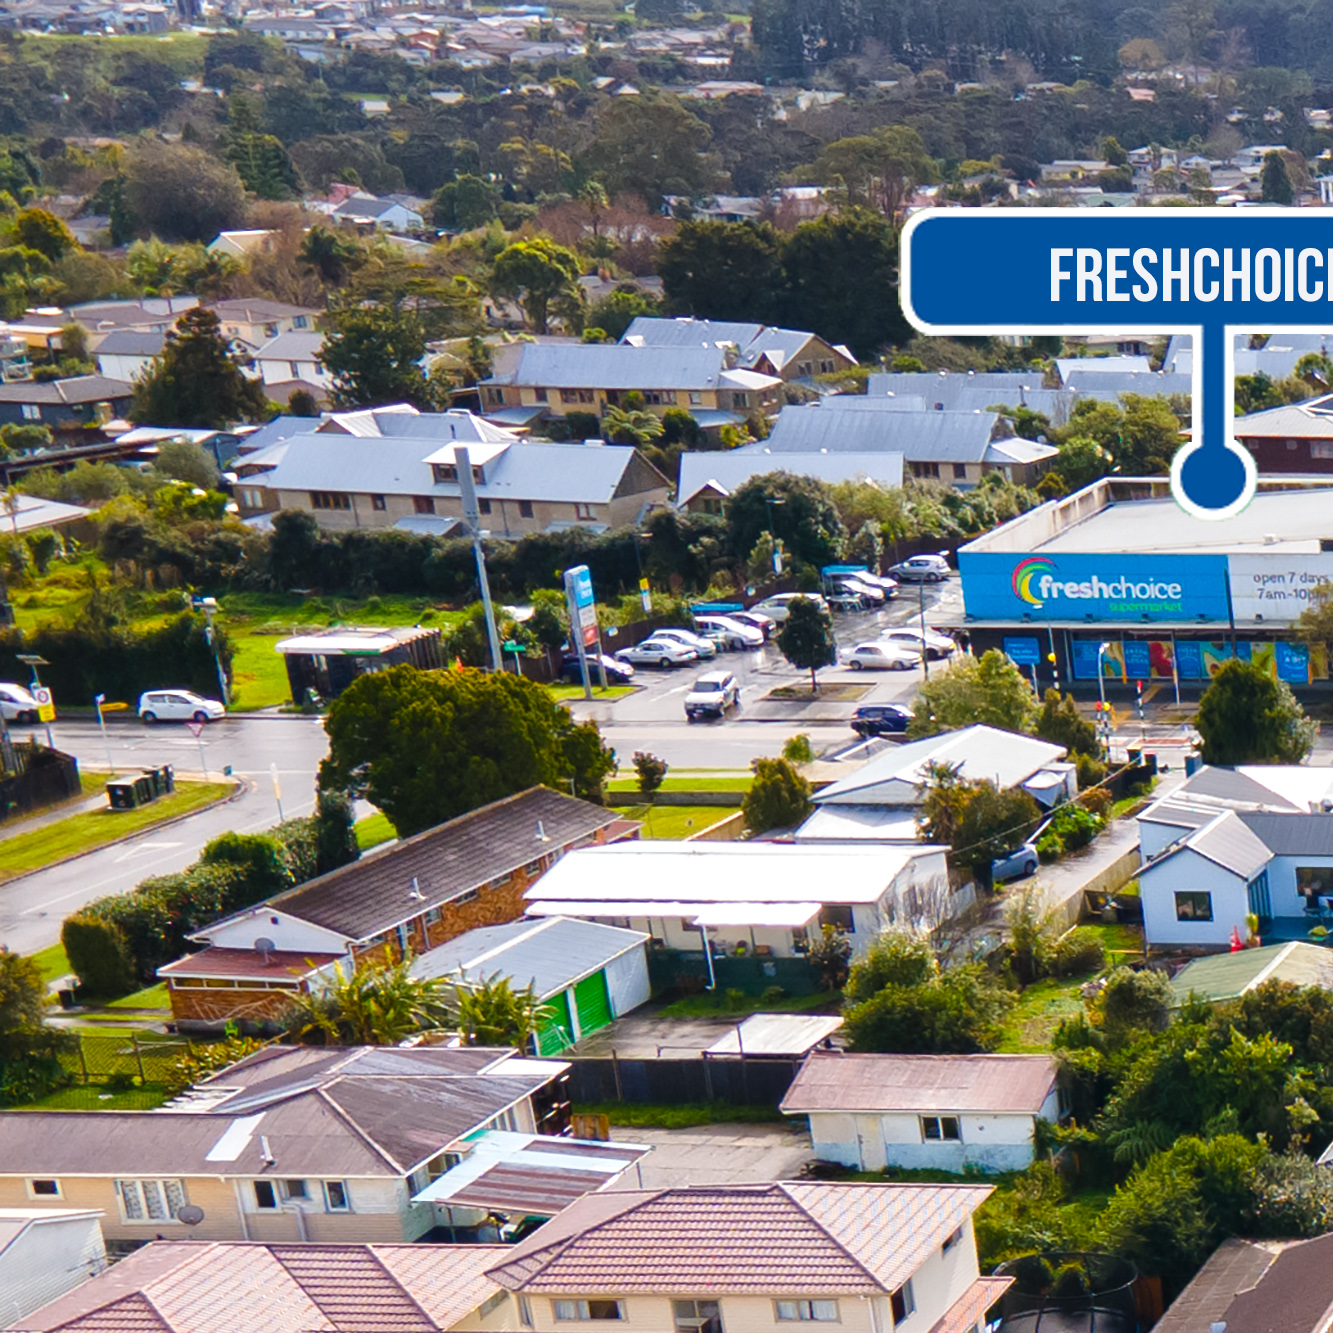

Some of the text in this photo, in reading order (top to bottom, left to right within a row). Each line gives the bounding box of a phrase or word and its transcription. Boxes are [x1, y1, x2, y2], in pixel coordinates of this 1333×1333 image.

[1253, 571, 1329, 586] open 7 days
[1038, 576, 1182, 599] freshchoice
[1109, 601, 1183, 613] supermarket
